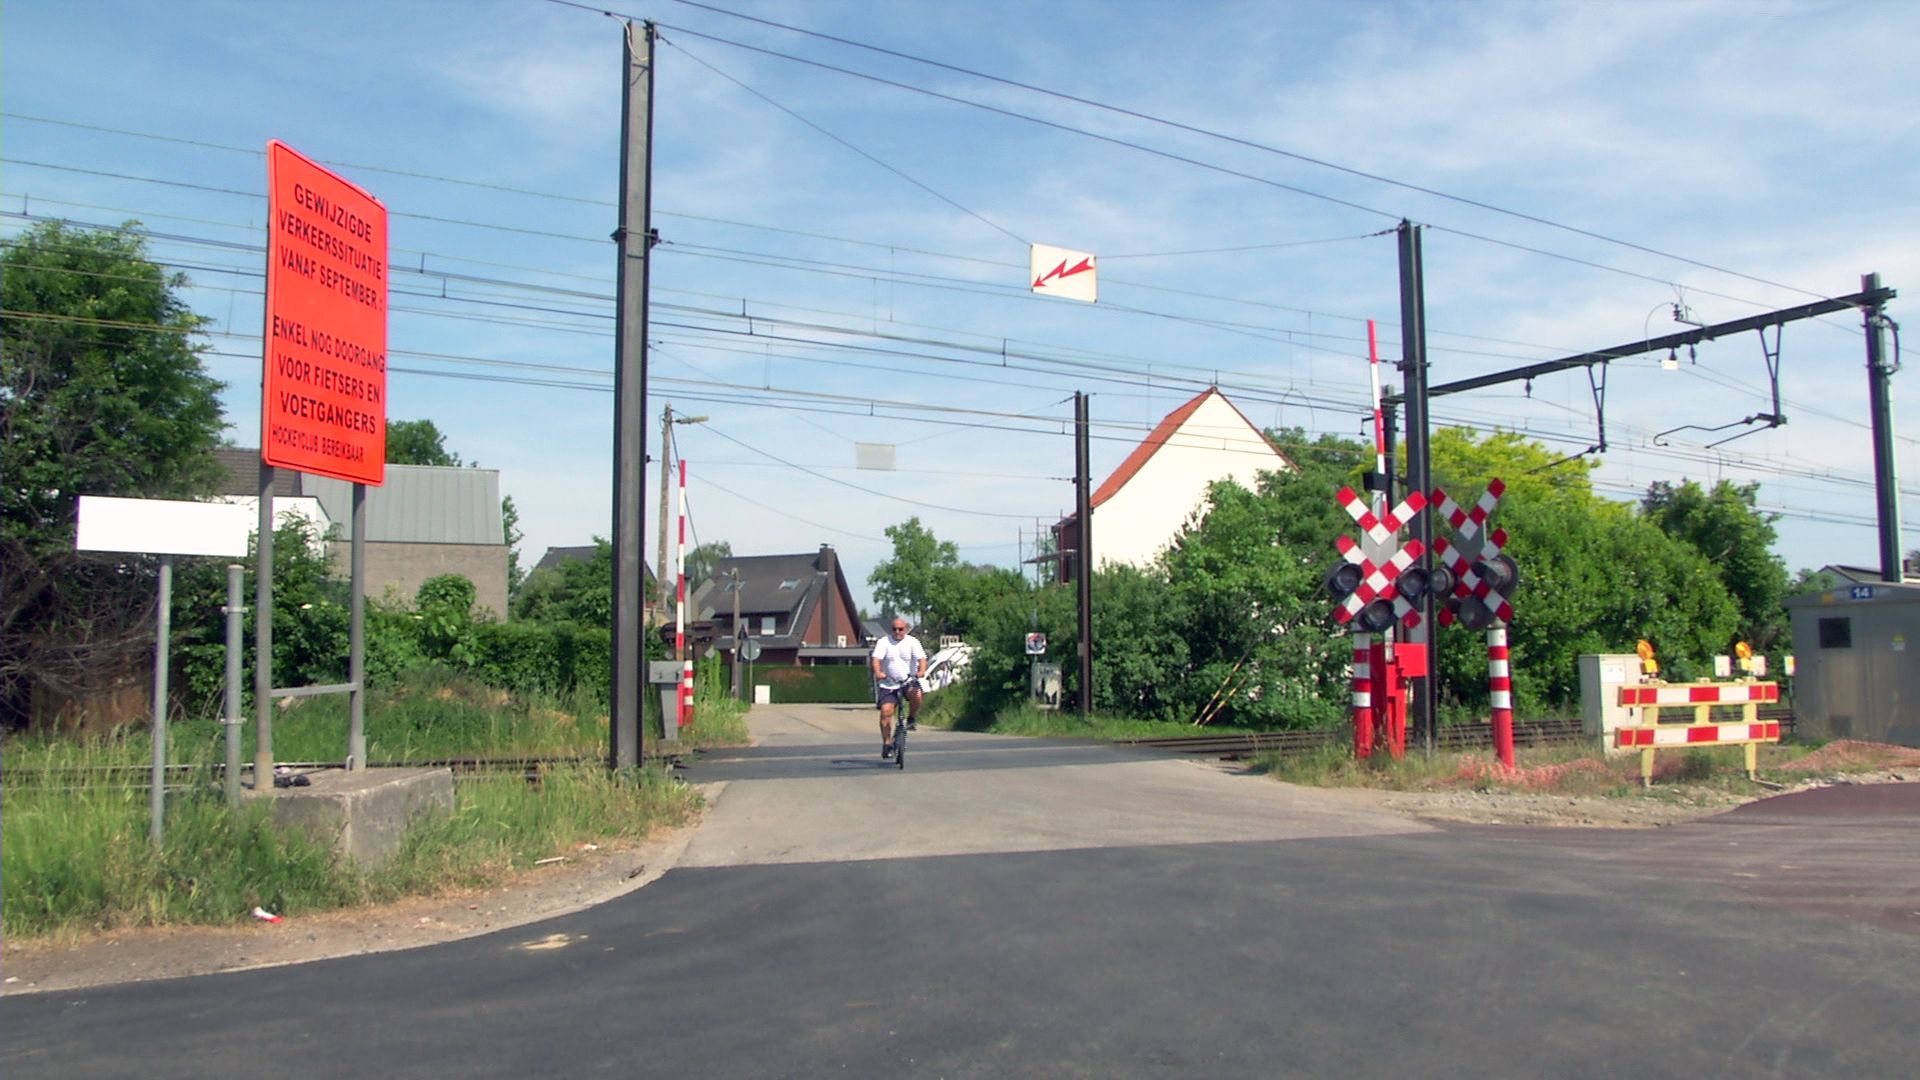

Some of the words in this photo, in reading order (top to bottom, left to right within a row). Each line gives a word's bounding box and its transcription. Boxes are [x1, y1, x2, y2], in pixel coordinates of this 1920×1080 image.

[294, 184, 371, 243] GEWIJZIGDE
[279, 209, 382, 280] VERKEERSSITUATIE
[280, 246, 316, 280] VANAF
[273, 315, 308, 347] ENKEL
[311, 329, 332, 355] NOG
[335, 338, 385, 373] DOORGANG
[278, 354, 311, 384] VOOR
[314, 366, 364, 400] FIETSERS
[368, 383, 380, 404] EN
[280, 391, 376, 435] VOETGANGERS
[272, 423, 318, 453] HOCKEYCLUB
[322, 437, 365, 462] BEREIKBAAR
[1853, 587, 1870, 598] 14
